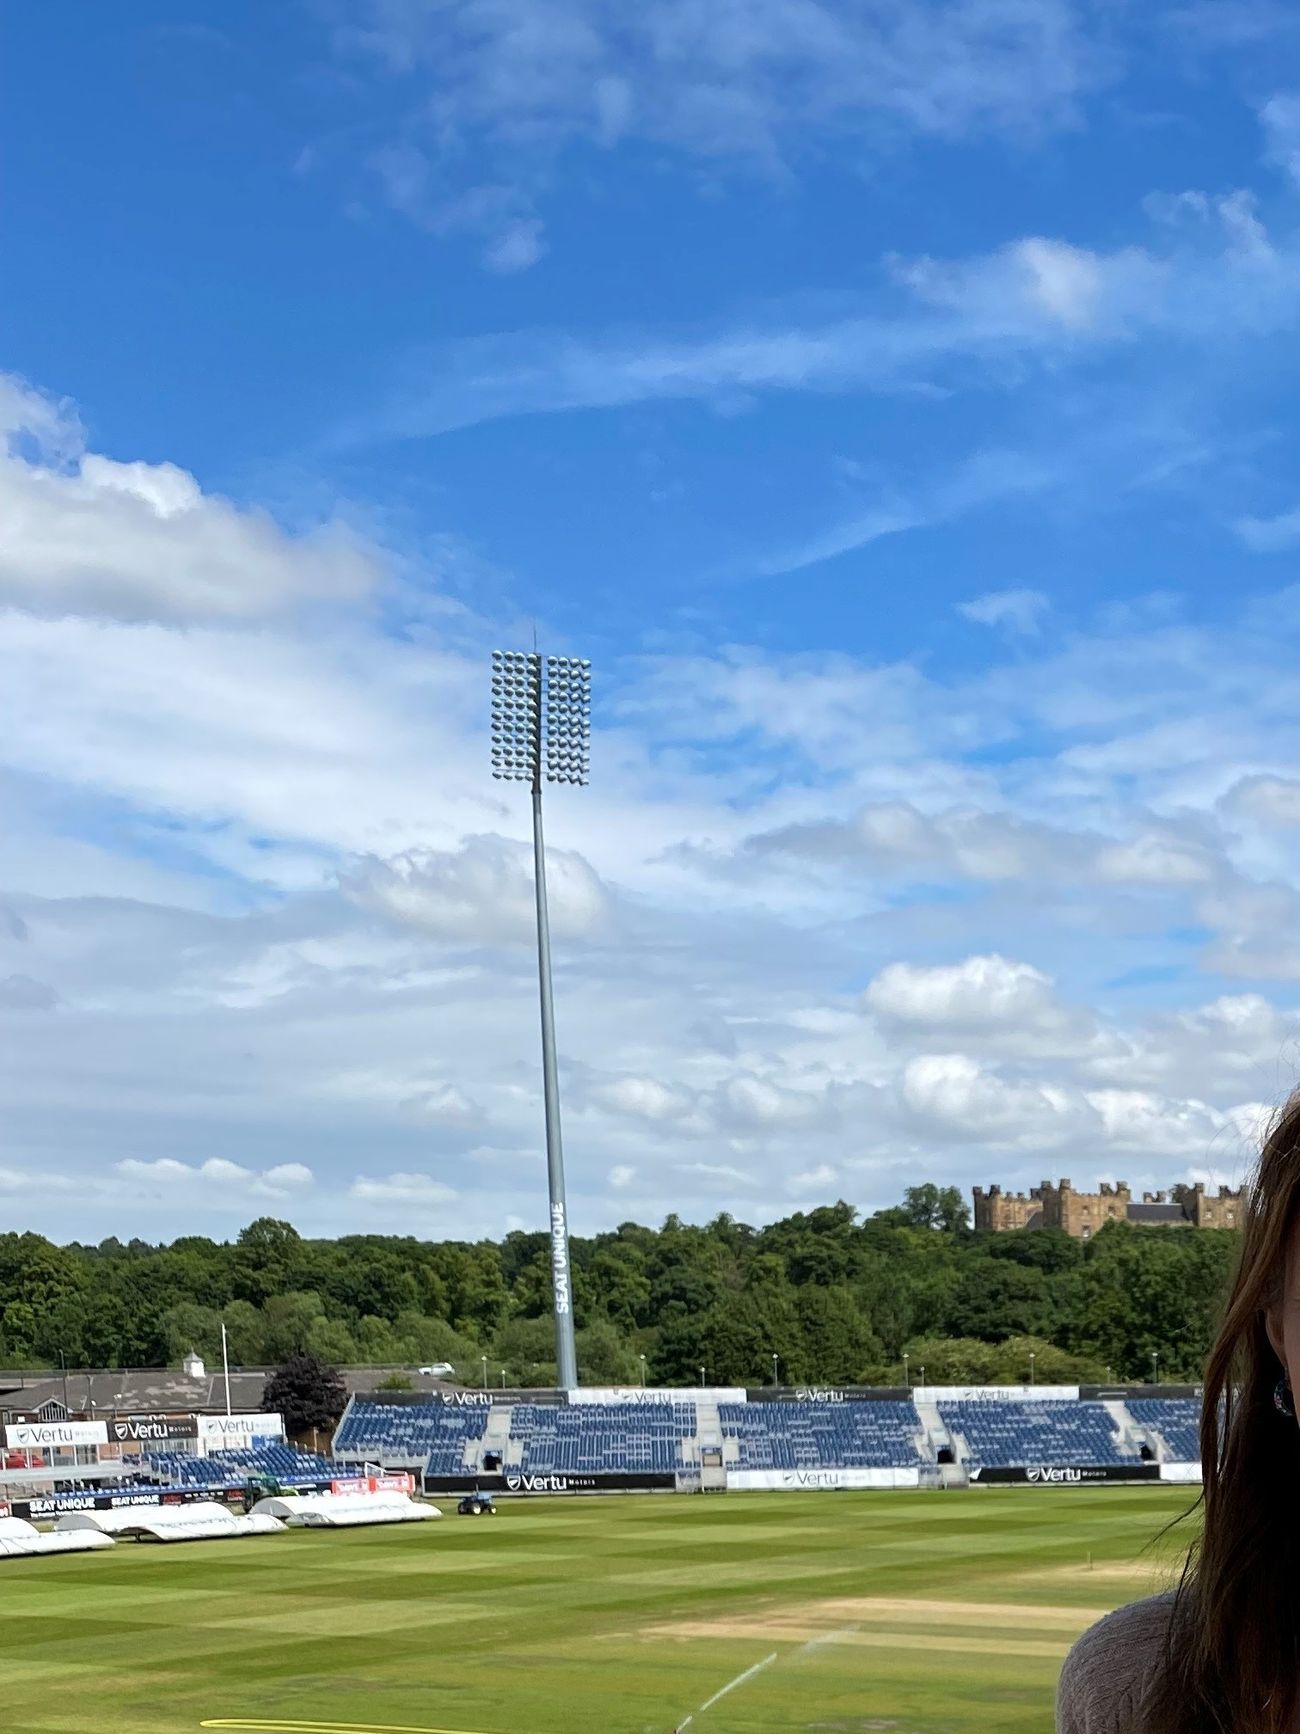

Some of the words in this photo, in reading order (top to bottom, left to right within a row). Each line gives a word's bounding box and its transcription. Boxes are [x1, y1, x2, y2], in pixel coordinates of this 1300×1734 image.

[551, 1202, 567, 1268] UNIQUE
[554, 1271, 569, 1314] SEAT
[455, 1392, 493, 1405] Vertu
[635, 1391, 671, 1402] Vertu
[808, 1389, 844, 1402] Vertu
[976, 1389, 1009, 1400] Vertu
[128, 1421, 168, 1440] Vertu
[218, 1420, 254, 1434] Vertu
[30, 1428, 73, 1443] Vertu
[798, 1472, 839, 1486] Vertu
[1040, 1467, 1081, 1482] Vertu
[522, 1475, 567, 1491] Vertu
[29, 1500, 56, 1513] SEAT
[56, 1497, 96, 1511] UNIQUE
[111, 1496, 131, 1506] SEAT
[131, 1494, 160, 1505] UNIQUE
